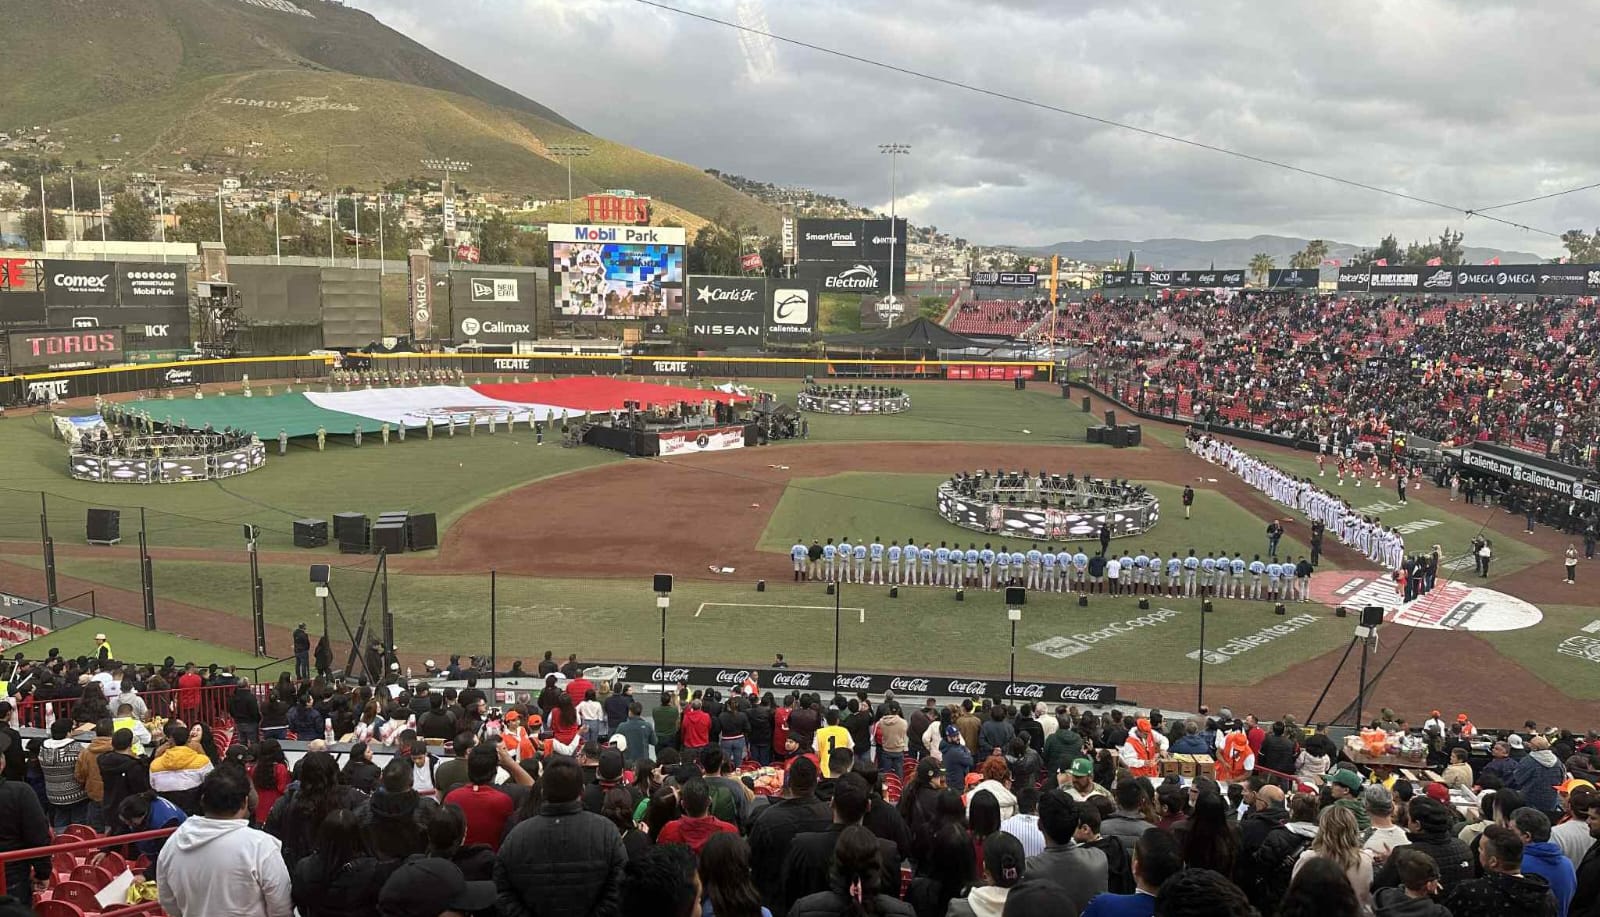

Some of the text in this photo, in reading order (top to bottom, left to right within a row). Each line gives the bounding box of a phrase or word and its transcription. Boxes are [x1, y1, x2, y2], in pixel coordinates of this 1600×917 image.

[586, 195, 649, 223] TOROS
[575, 227, 658, 242] Mobil Park
[54, 273, 110, 287] Comex
[825, 276, 879, 288] Electrolit
[711, 289, 740, 301] Carl's
[482, 321, 530, 333] Calimax
[694, 325, 759, 335] NISSAN
[769, 325, 811, 333] caliente.mx
[26, 333, 115, 356] TOROS
[493, 358, 531, 369] TECATE
[652, 361, 688, 372] TECATE
[1470, 455, 1512, 476] caliente.mx
[1521, 471, 1571, 495] caliente.mx
[1072, 607, 1182, 644] BanCoppel
[1216, 612, 1323, 656] caliente.mx
[652, 667, 690, 681] Coa-Cola
[773, 672, 812, 687] Coca-Cola
[890, 677, 930, 692] Coca-Cola
[948, 680, 987, 695] Coca-Cola
[1060, 686, 1102, 701] Coca-Cola
[827, 735, 836, 754] 1
